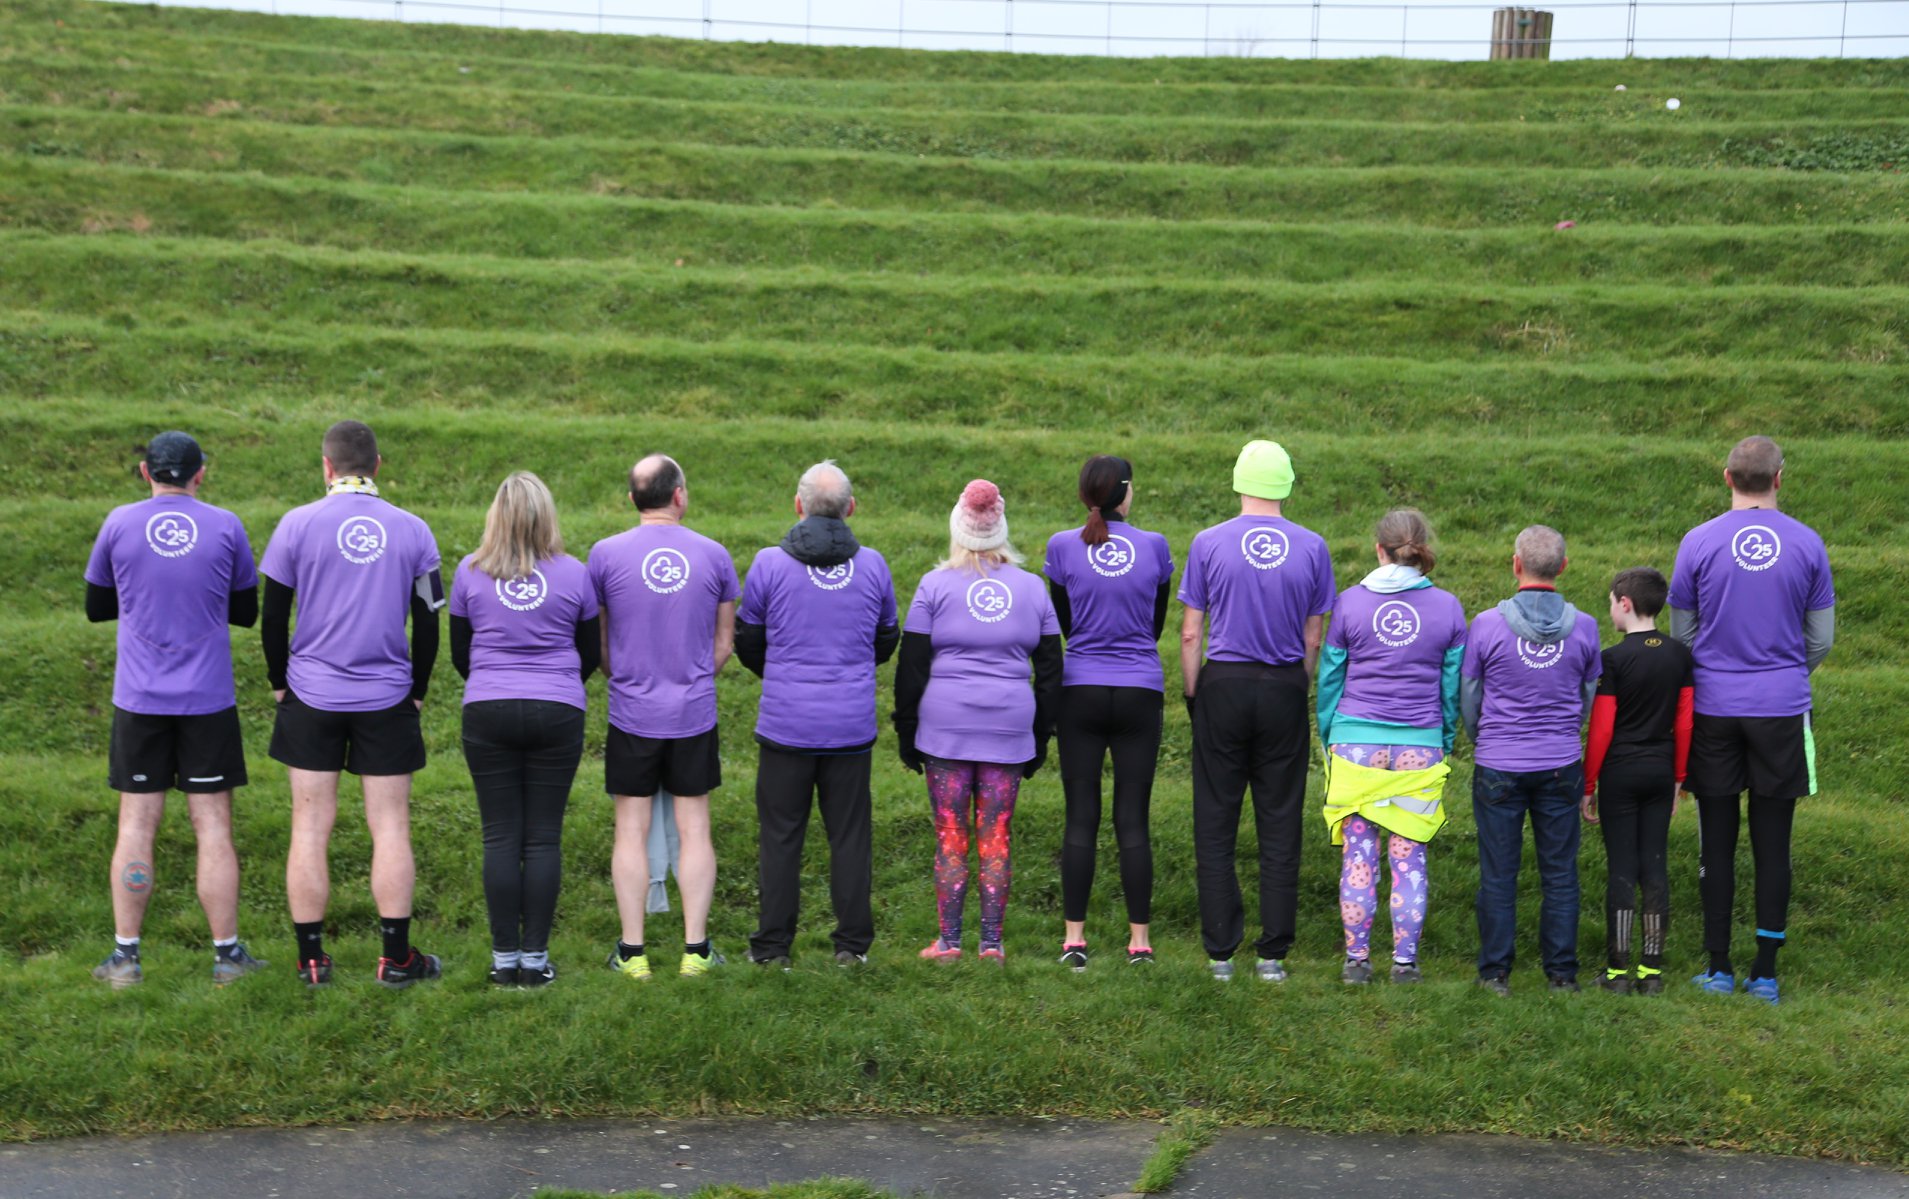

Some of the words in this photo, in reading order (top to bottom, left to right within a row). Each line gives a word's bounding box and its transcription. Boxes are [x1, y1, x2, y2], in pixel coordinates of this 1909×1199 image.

[167, 530, 189, 546] 25
[357, 535, 378, 552] 25
[150, 542, 194, 558] VOLUNTEER
[340, 547, 384, 564] VOLUNTEER
[1260, 543, 1280, 559] 25
[1751, 544, 1772, 560] 25
[1107, 551, 1127, 566] 25
[1245, 554, 1286, 570] VOLUNTEER
[1735, 556, 1778, 572] VOLUNTEER
[661, 566, 680, 582] 25
[1092, 563, 1133, 577] VOLUNTEER
[644, 579, 687, 594] VOLUNTEER
[810, 575, 851, 591] VOLUNTEER
[517, 583, 537, 600] 25
[499, 597, 544, 611] VOLUNTEER
[985, 596, 1004, 612] 25
[968, 607, 1010, 623] VOLUNTEER
[1391, 620, 1411, 636] 25
[1375, 632, 1418, 647] VOLUNTEER
[1521, 653, 1562, 670] VOLUNTEER
